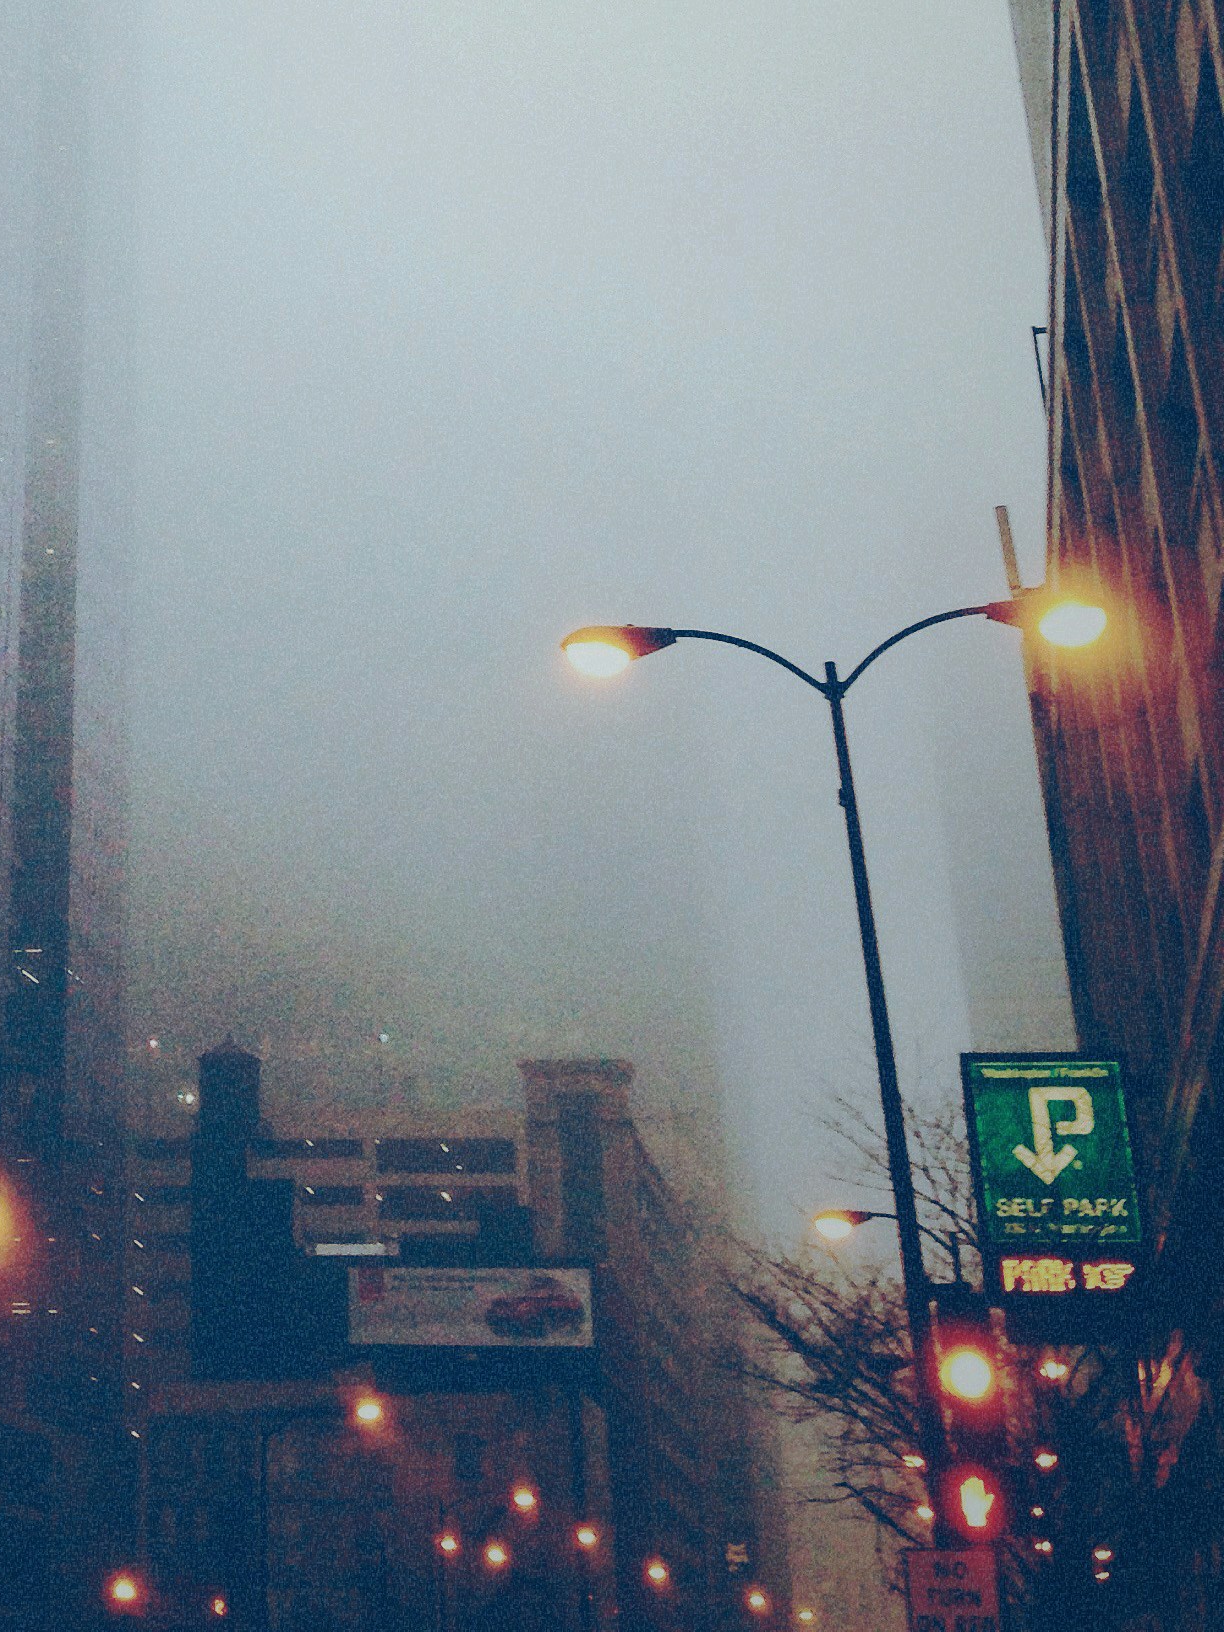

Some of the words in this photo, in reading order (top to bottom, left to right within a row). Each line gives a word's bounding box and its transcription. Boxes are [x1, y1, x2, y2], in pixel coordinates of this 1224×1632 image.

[1014, 1087, 1094, 1184] P
[996, 1198, 1054, 1217] SELF
[1062, 1198, 1128, 1217] PARK
[934, 1561, 967, 1580] NO
[927, 1587, 982, 1607] TURN
